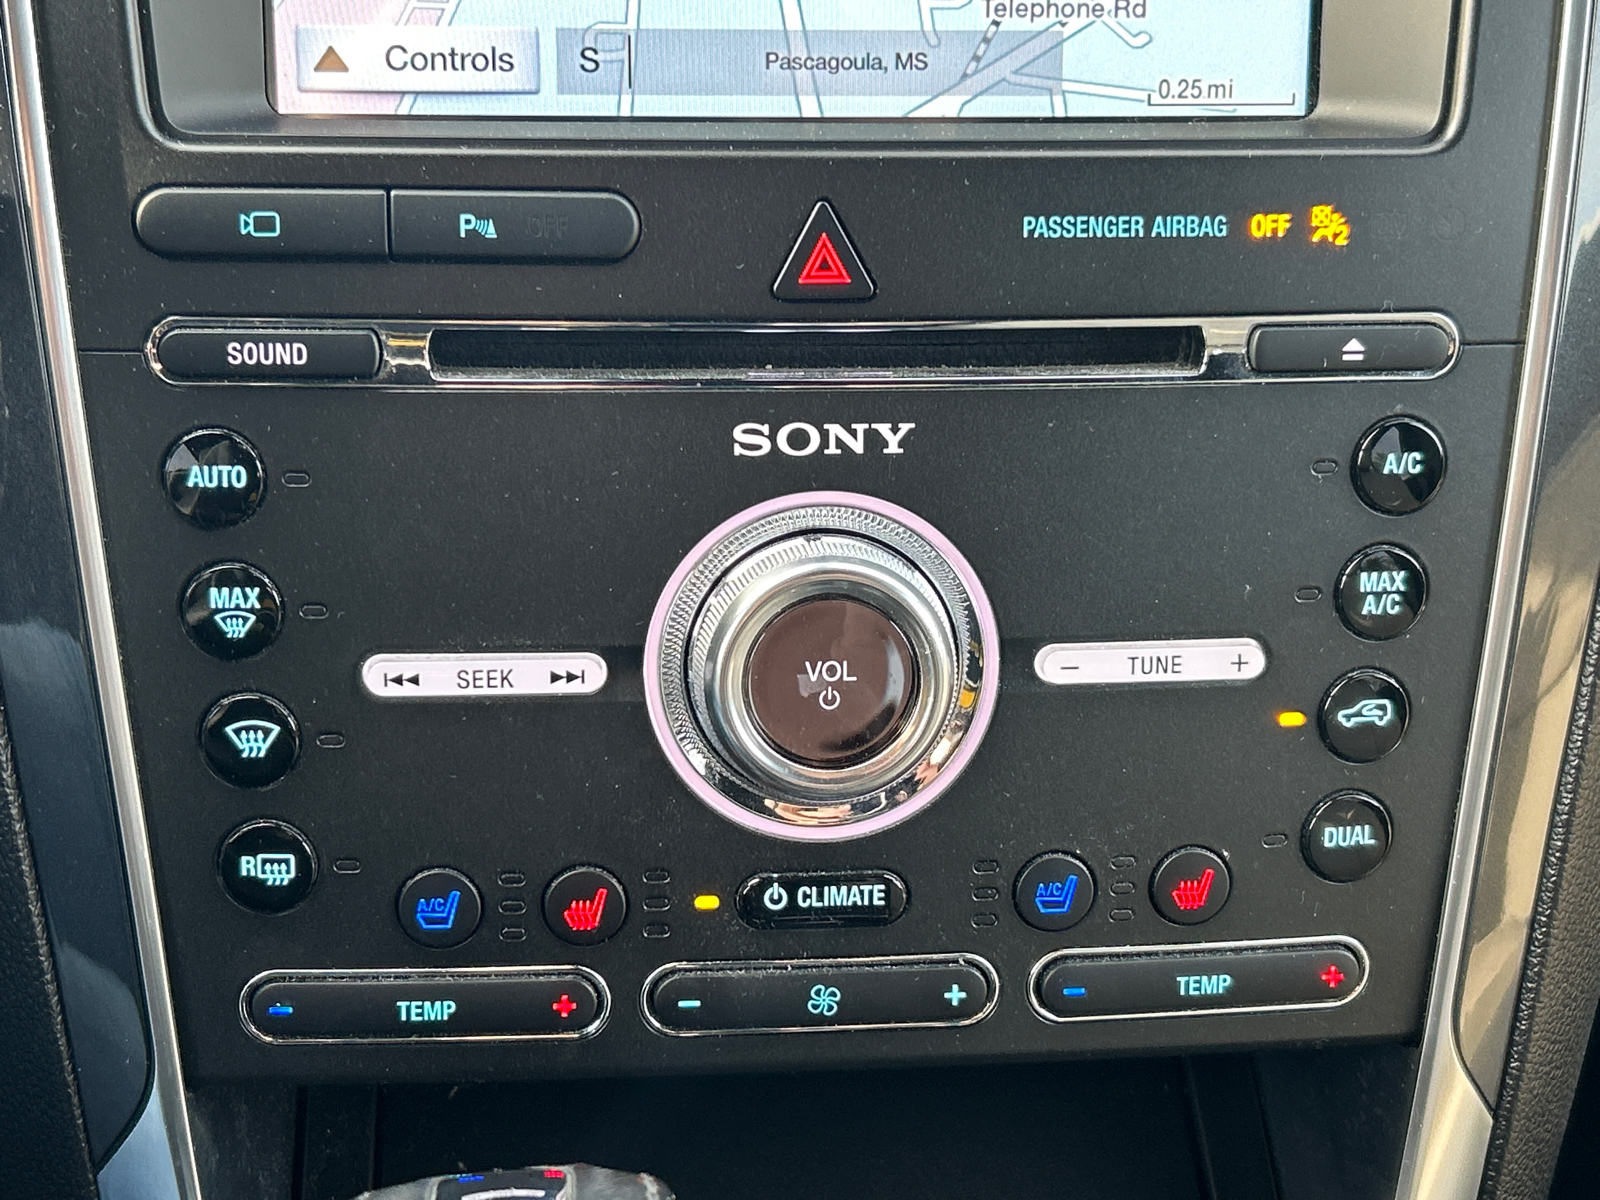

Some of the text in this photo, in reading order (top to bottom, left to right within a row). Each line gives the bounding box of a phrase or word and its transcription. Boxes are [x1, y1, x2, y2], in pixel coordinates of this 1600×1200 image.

[982, 0, 1147, 22] Telephone Rd
[385, 45, 514, 73] Controls
[579, 46, 600, 73] S
[765, 51, 928, 75] Pascagoula, MS
[1159, 79, 1233, 99] 0.25 mi
[1023, 213, 1292, 239] PASSENGER AIRBAG OFF
[226, 341, 308, 367] SOUND
[733, 422, 916, 456] SONY
[1382, 452, 1423, 476] A/C
[187, 464, 248, 491] AUTO
[1359, 570, 1405, 593] MAX
[209, 586, 261, 610] MAX
[1360, 593, 1402, 616] A/C
[805, 660, 857, 683] VOL
[1127, 654, 1182, 676] TUNE
[456, 668, 514, 690] SEEK
[1323, 824, 1375, 848] DUAL
[797, 884, 886, 908] CLIMATE
[1036, 882, 1062, 896] A/C
[417, 898, 445, 912] A/C
[1176, 974, 1233, 998] TEMP
[397, 1000, 457, 1022] TEMP
